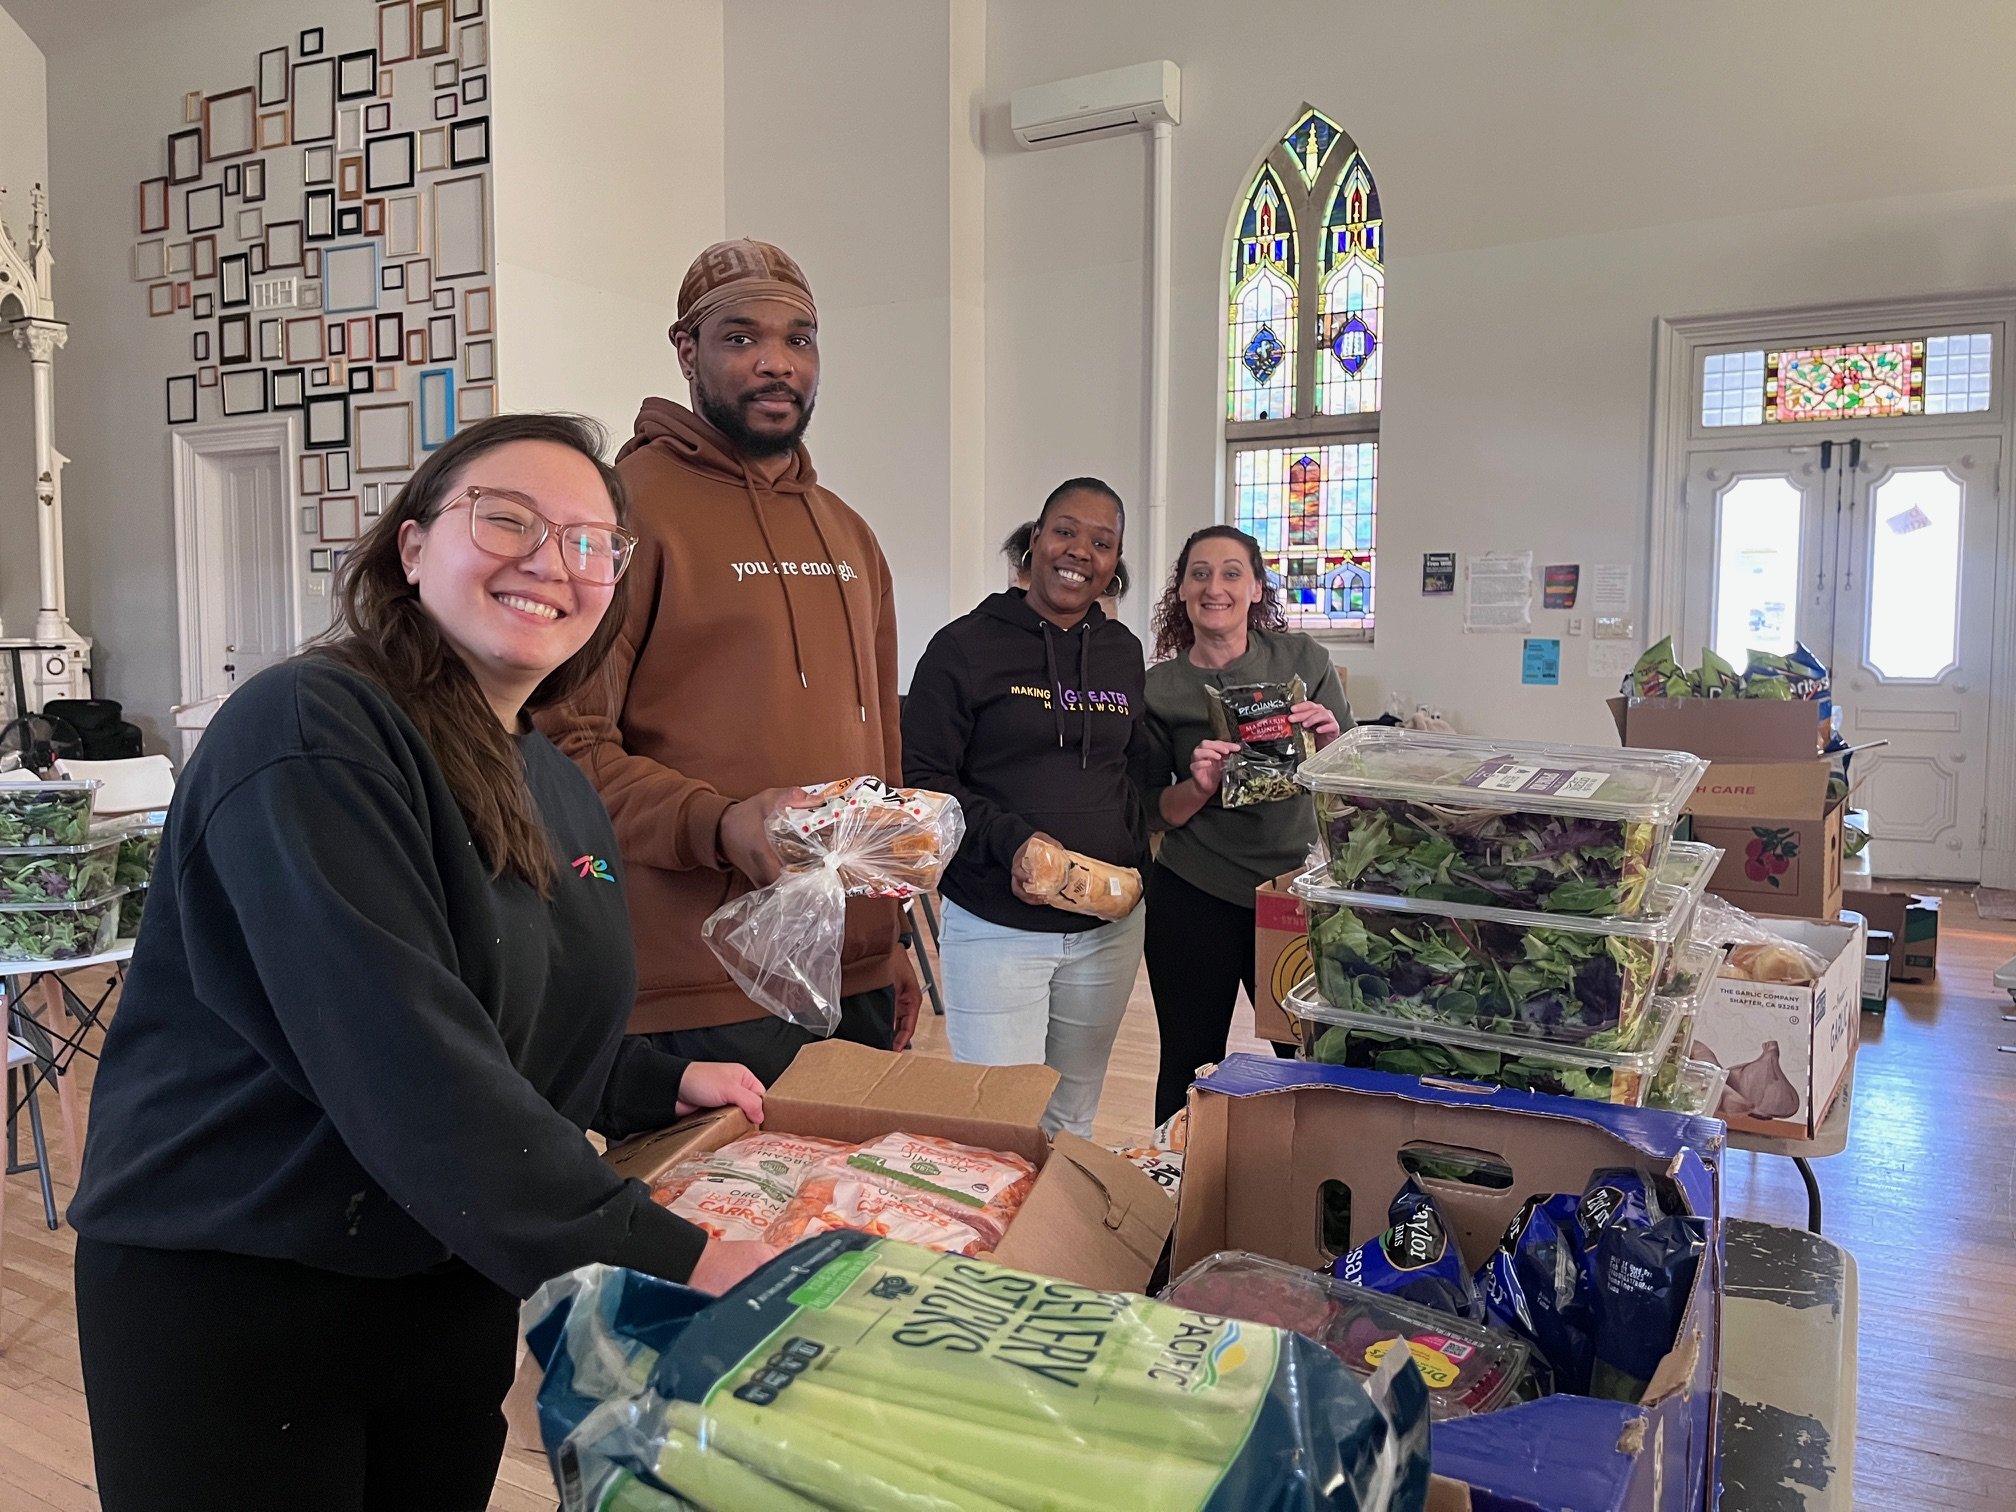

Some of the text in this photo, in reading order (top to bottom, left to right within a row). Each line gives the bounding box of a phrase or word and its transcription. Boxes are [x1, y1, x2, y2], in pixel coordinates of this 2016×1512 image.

[731, 562, 770, 581] you
[1010, 685, 1129, 707] MAKING GEATER
[1790, 676, 1830, 696] oritos
[1711, 785, 1757, 795] CARE
[1729, 998, 1799, 1011] SHAFTER, CA 93263
[1735, 990, 1762, 998] GARLIC
[1763, 993, 1799, 1002] COMPANY
[729, 1189, 785, 1215] ORGANI
[698, 1201, 770, 1228] CARRO
[1394, 1224, 1405, 1248] RMS
[892, 1263, 1038, 1353] STICKS
[991, 1283, 1131, 1388] CELERY
[1147, 1310, 1225, 1392] PACIFIC
